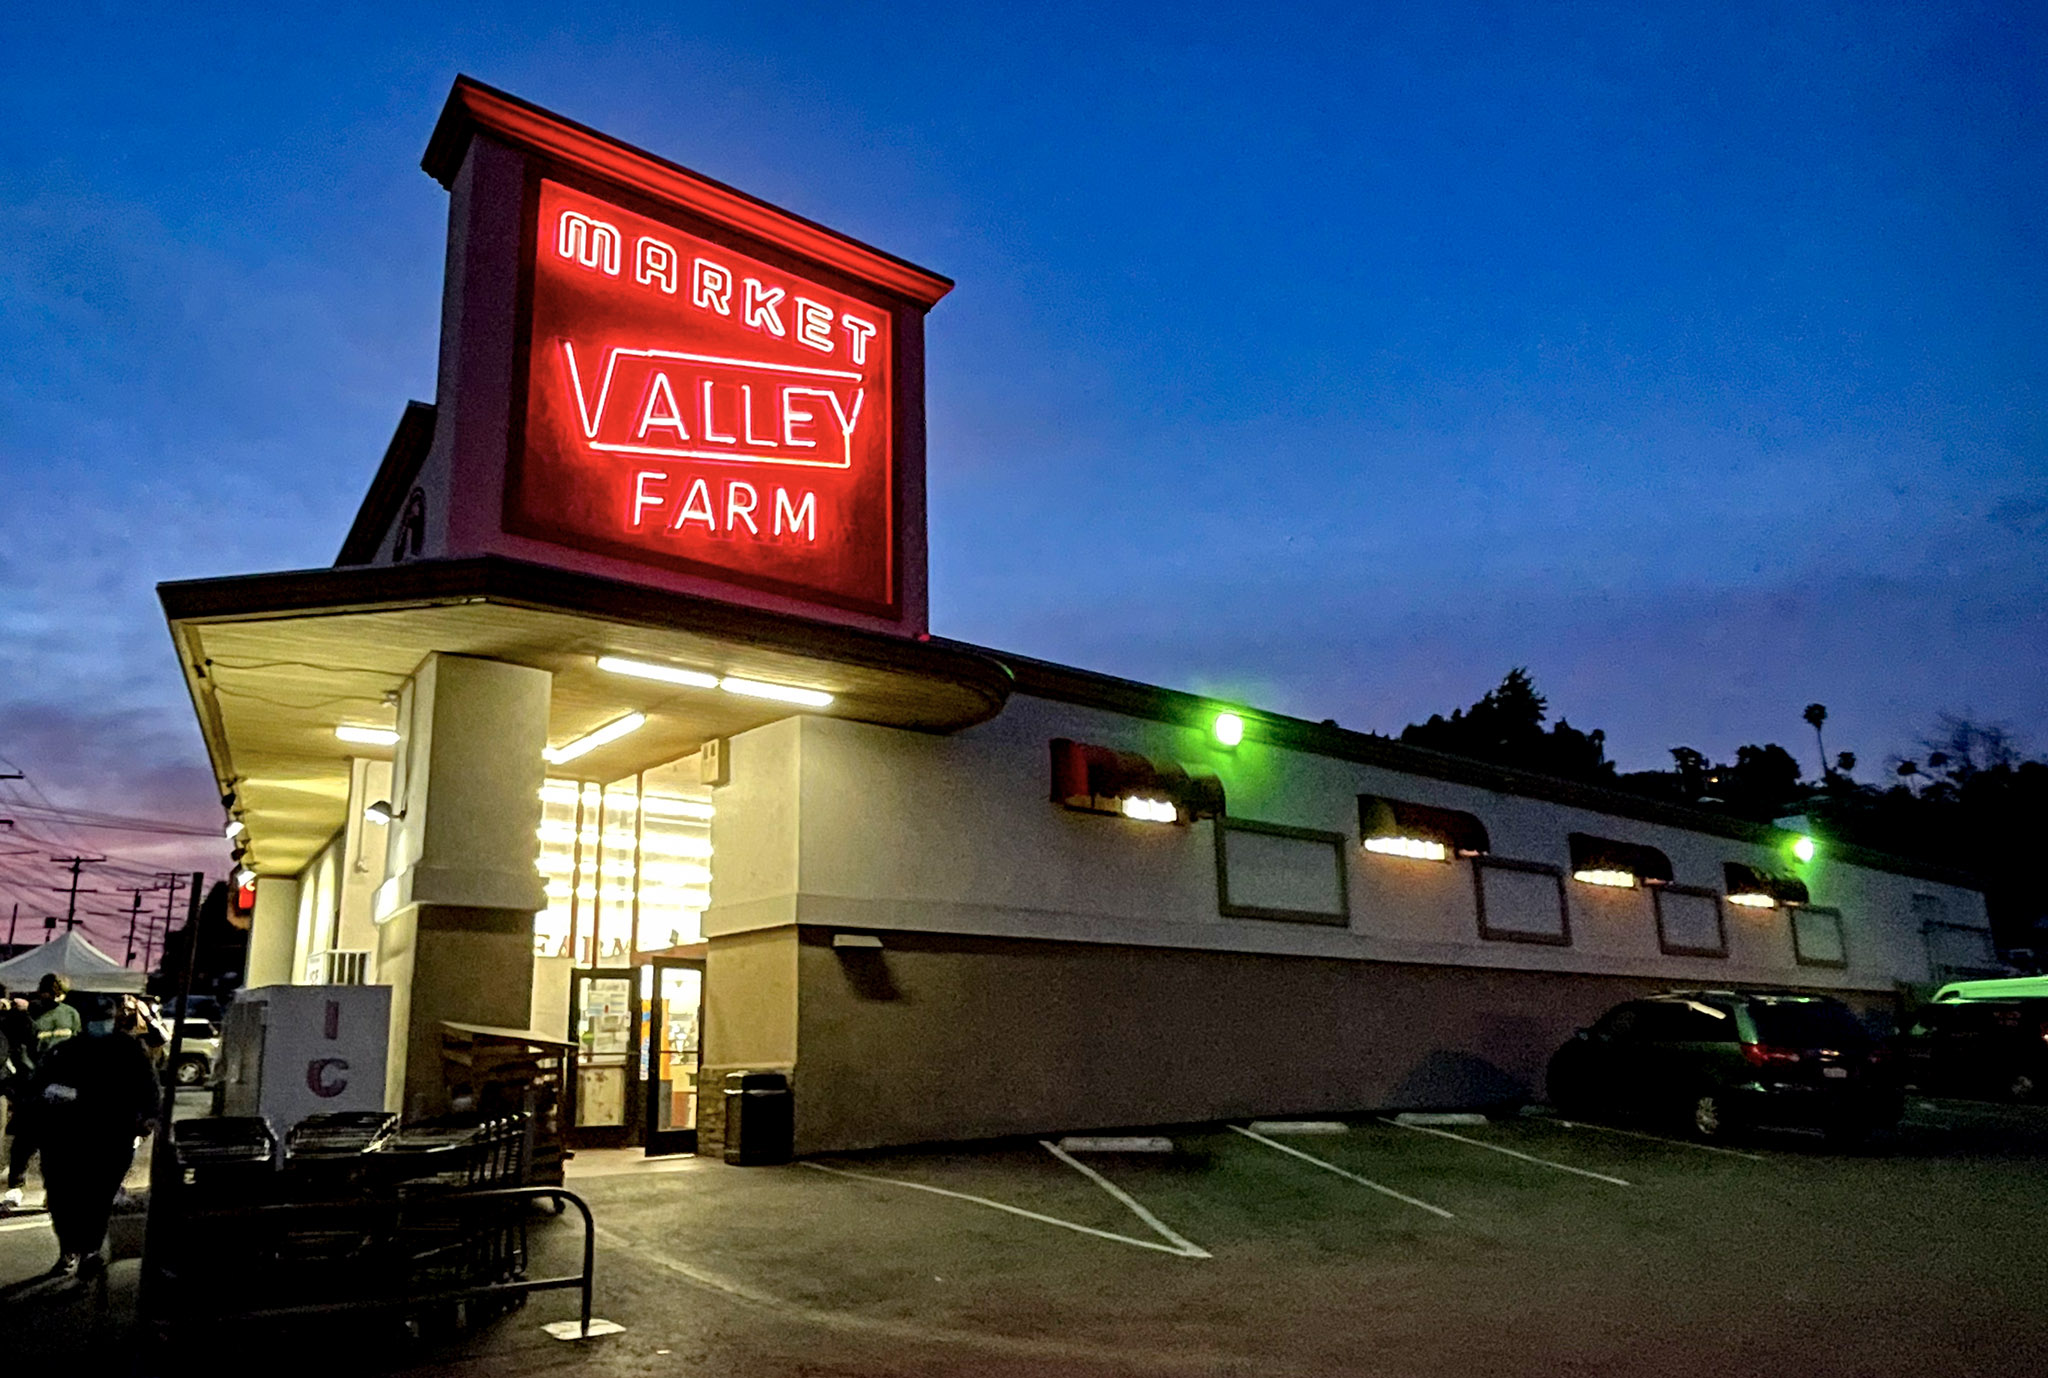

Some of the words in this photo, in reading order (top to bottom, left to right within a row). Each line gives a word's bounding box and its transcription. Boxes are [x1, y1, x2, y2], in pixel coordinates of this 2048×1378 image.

[558, 210, 877, 366] MARKET
[564, 341, 865, 468] VALLEY
[632, 472, 816, 542] FARM
